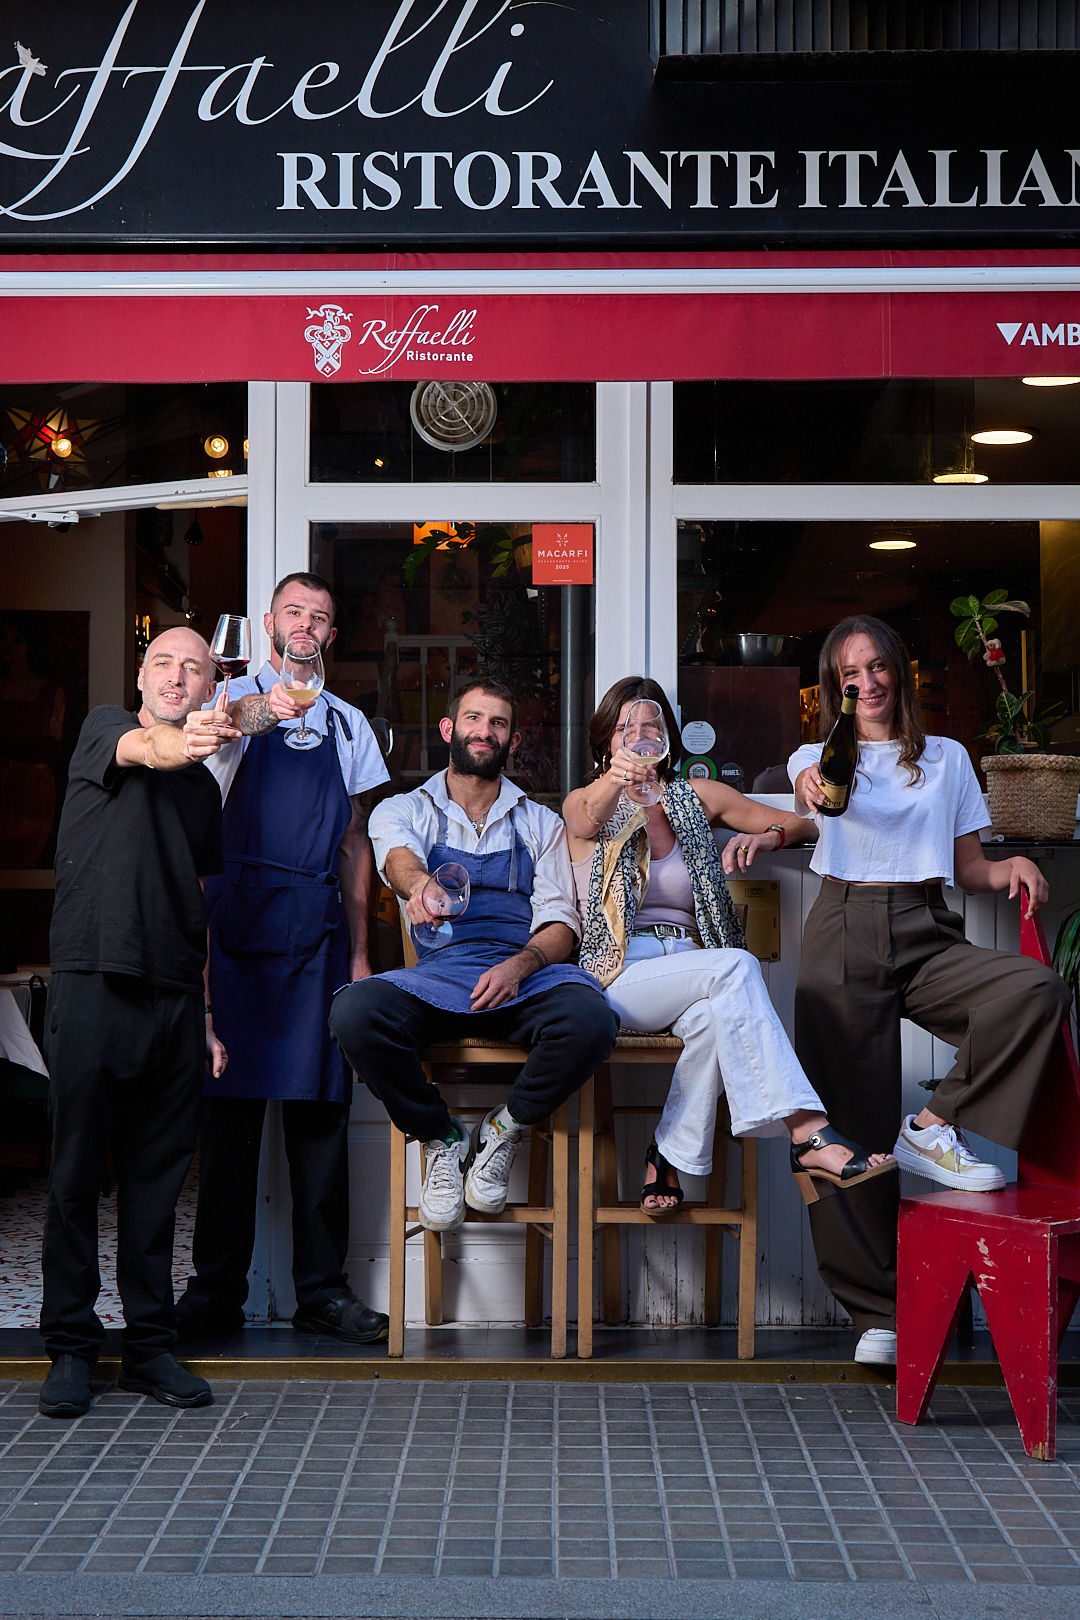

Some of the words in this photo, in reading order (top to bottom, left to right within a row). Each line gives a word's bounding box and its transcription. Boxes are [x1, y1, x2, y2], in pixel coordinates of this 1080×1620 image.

[0, 0, 554, 222] affaelli
[276, 150, 779, 210] RISTORANTE
[358, 304, 478, 375] Raffaelli
[406, 350, 474, 362] Ristorante
